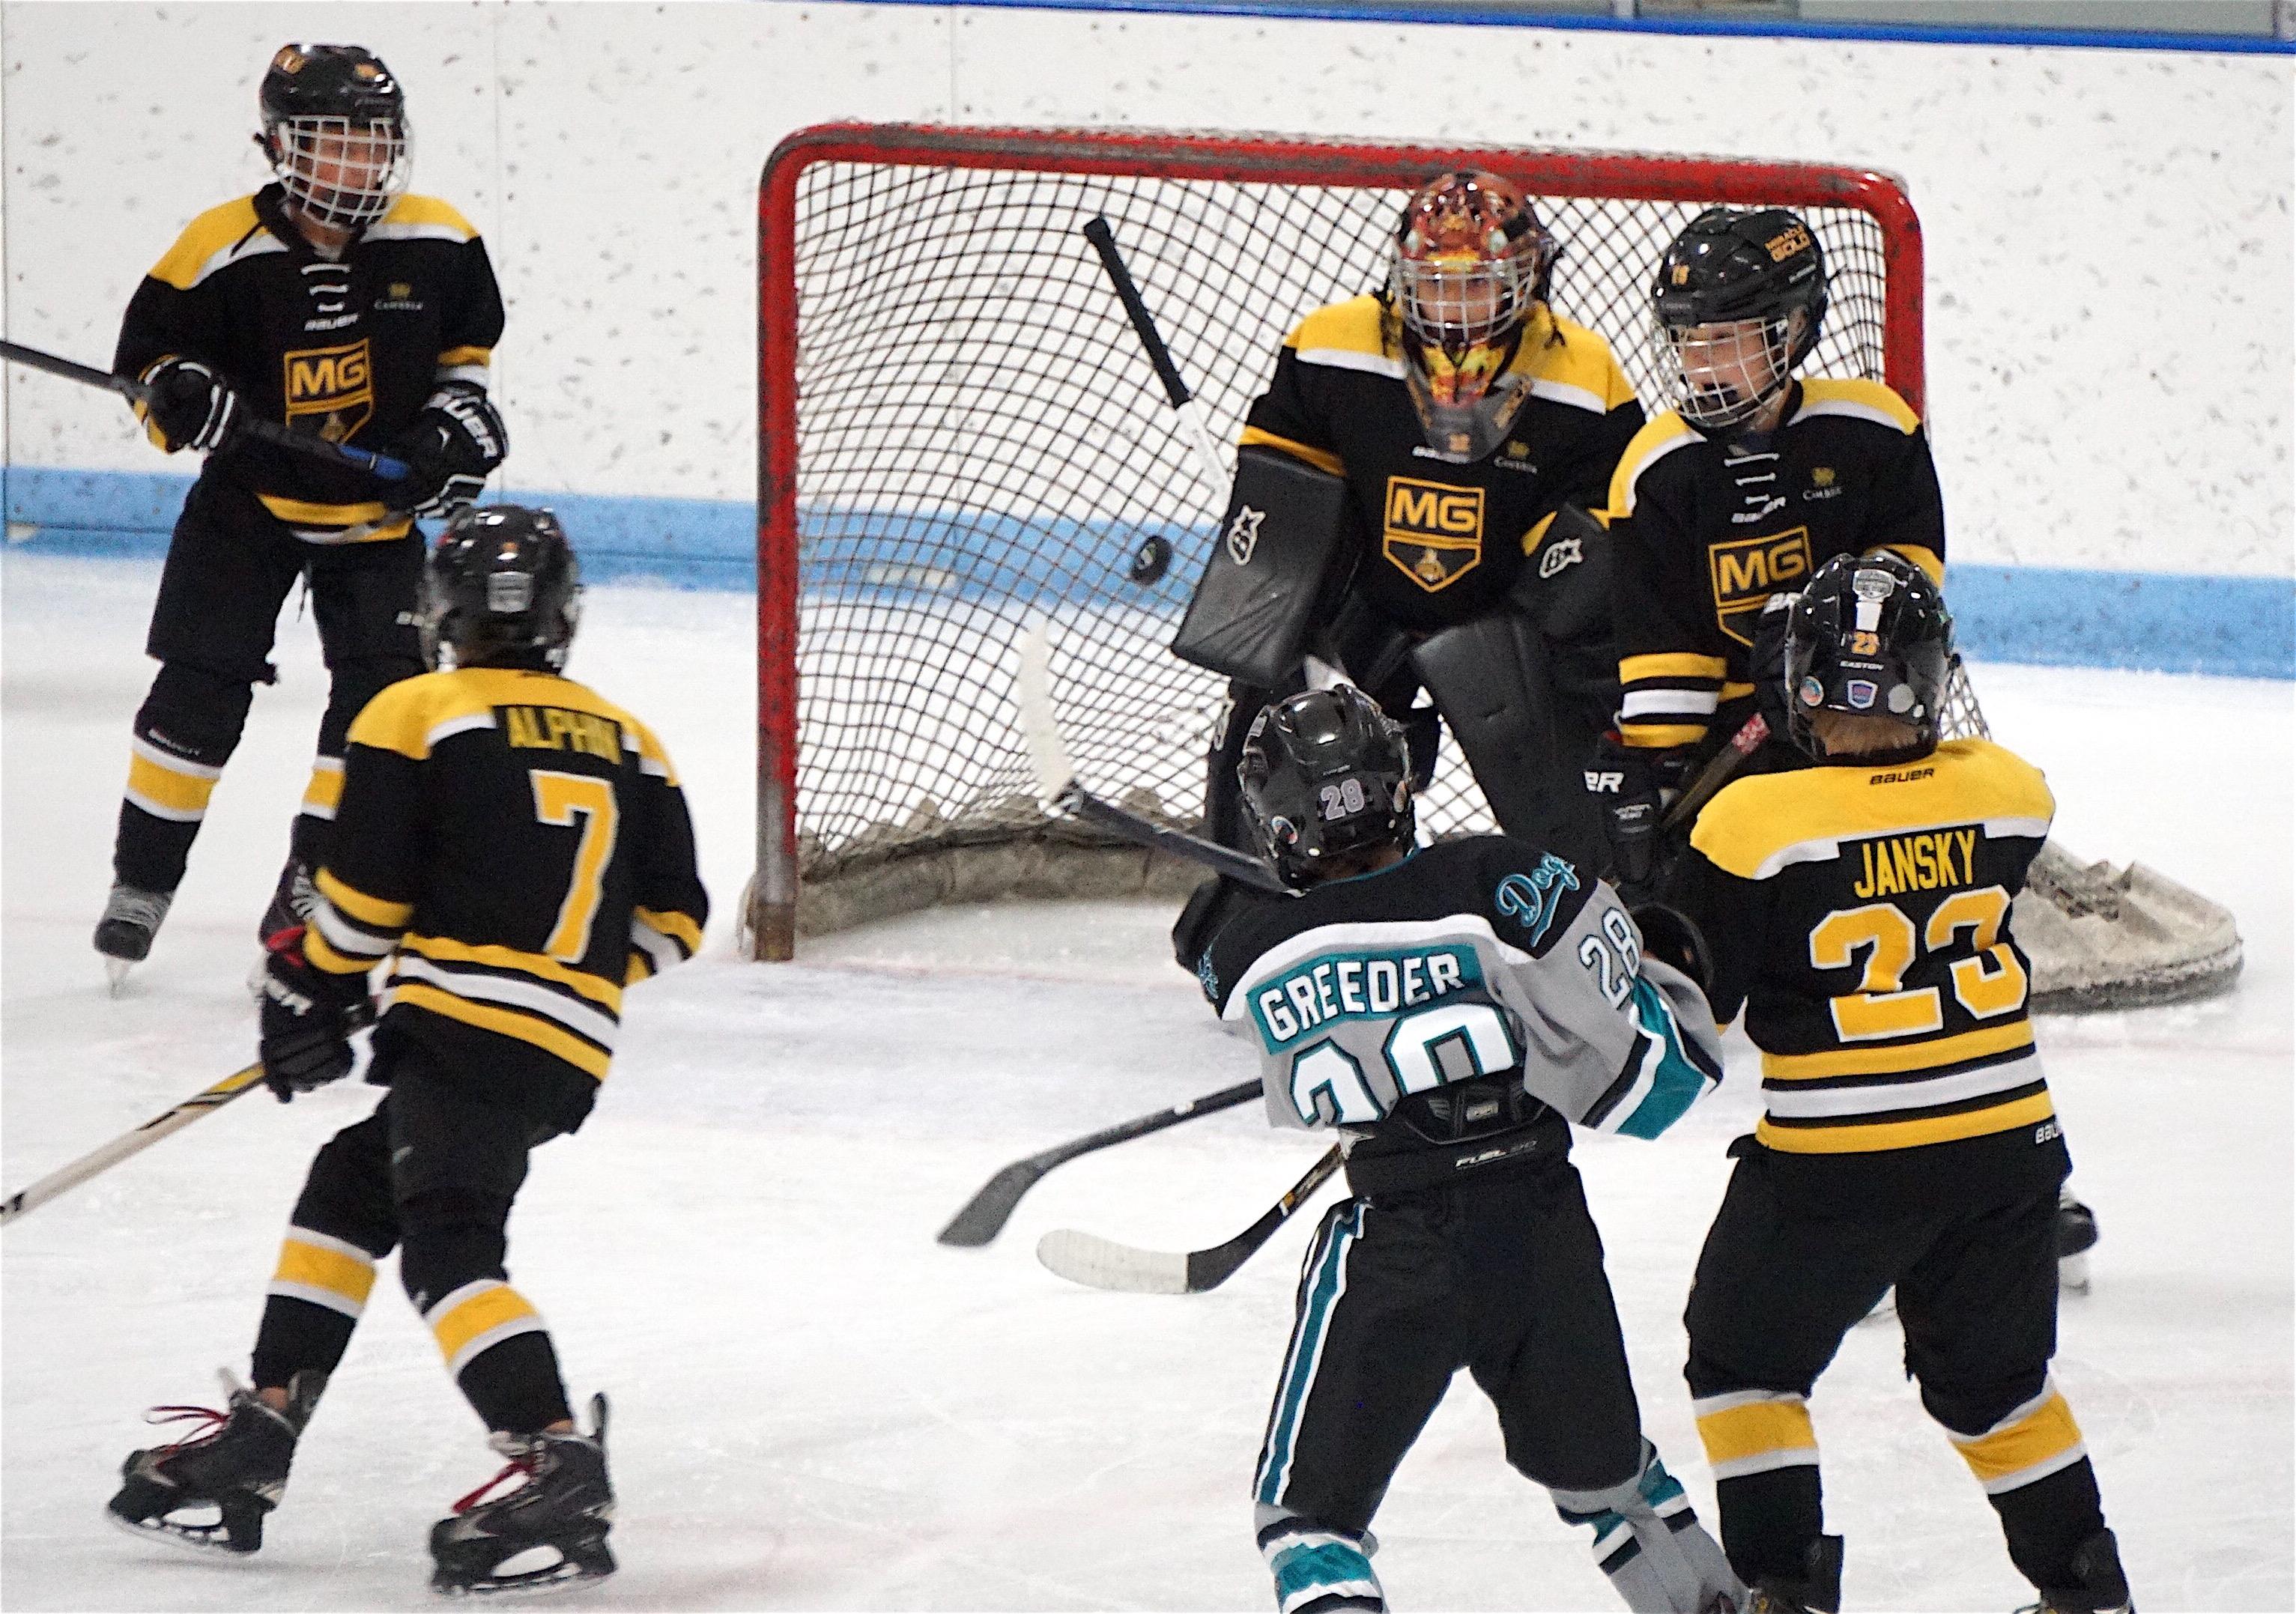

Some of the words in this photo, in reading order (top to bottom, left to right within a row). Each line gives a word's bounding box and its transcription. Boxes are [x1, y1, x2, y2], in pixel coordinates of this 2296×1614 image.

[292, 351, 365, 396] MG
[1392, 488, 1477, 533] MG
[1719, 538, 1805, 594] MG
[1840, 660, 1885, 671] EASTON
[1320, 777, 1365, 821] 28
[1870, 768, 1935, 785] BAUER
[529, 769, 620, 964] 7
[1854, 829, 1975, 898] JANSKY
[1578, 907, 1641, 1010] 28
[1809, 884, 2029, 1043] 23
[1258, 952, 1465, 1043] GREEDER
